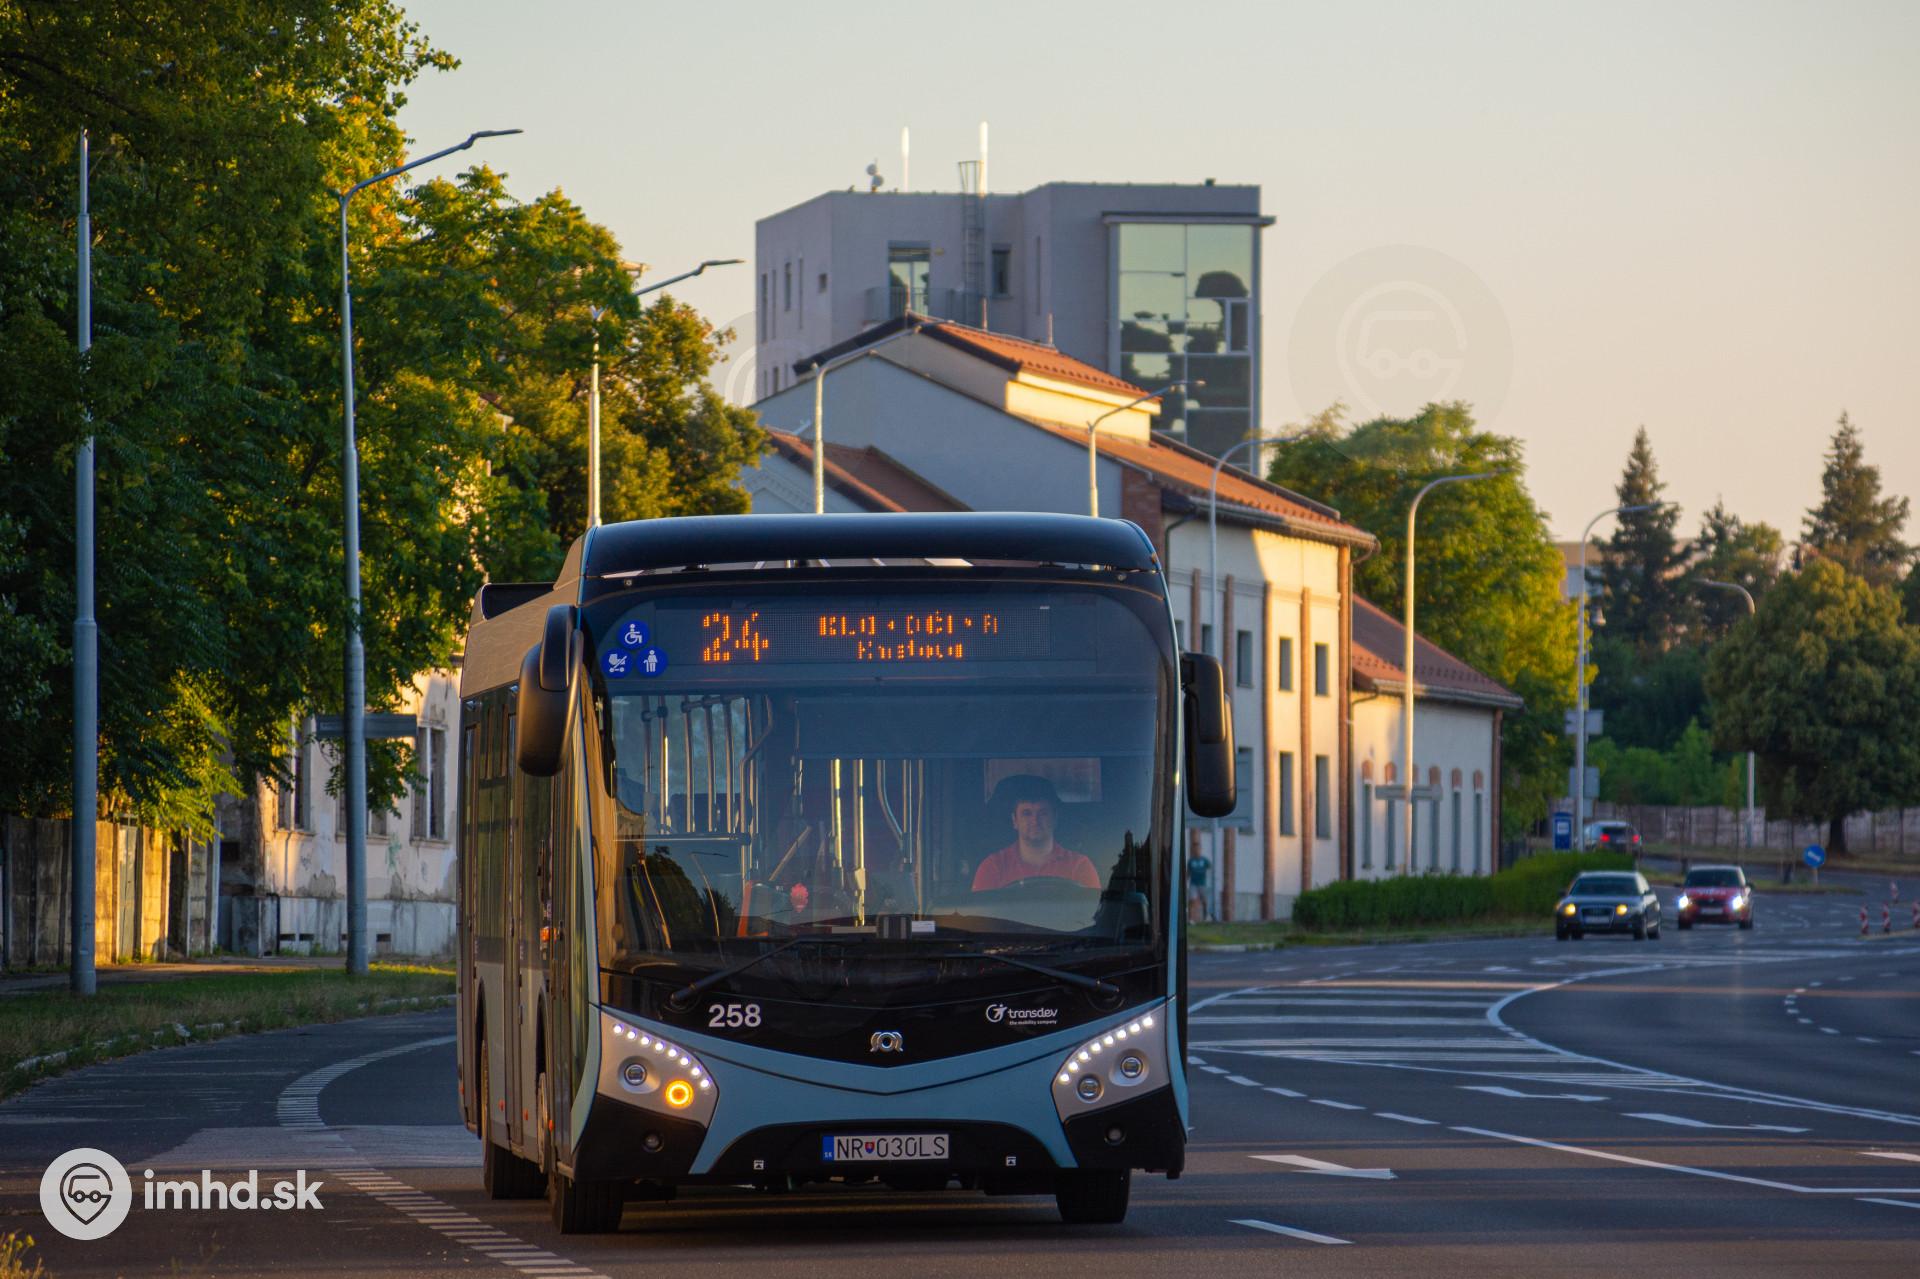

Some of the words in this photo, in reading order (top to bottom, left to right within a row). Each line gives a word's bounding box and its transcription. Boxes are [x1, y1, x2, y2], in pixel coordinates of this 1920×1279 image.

[703, 612, 769, 661] 24
[708, 1003, 762, 1028] 258
[1008, 1007, 1058, 1019] transdev
[837, 1138, 863, 1159] NR
